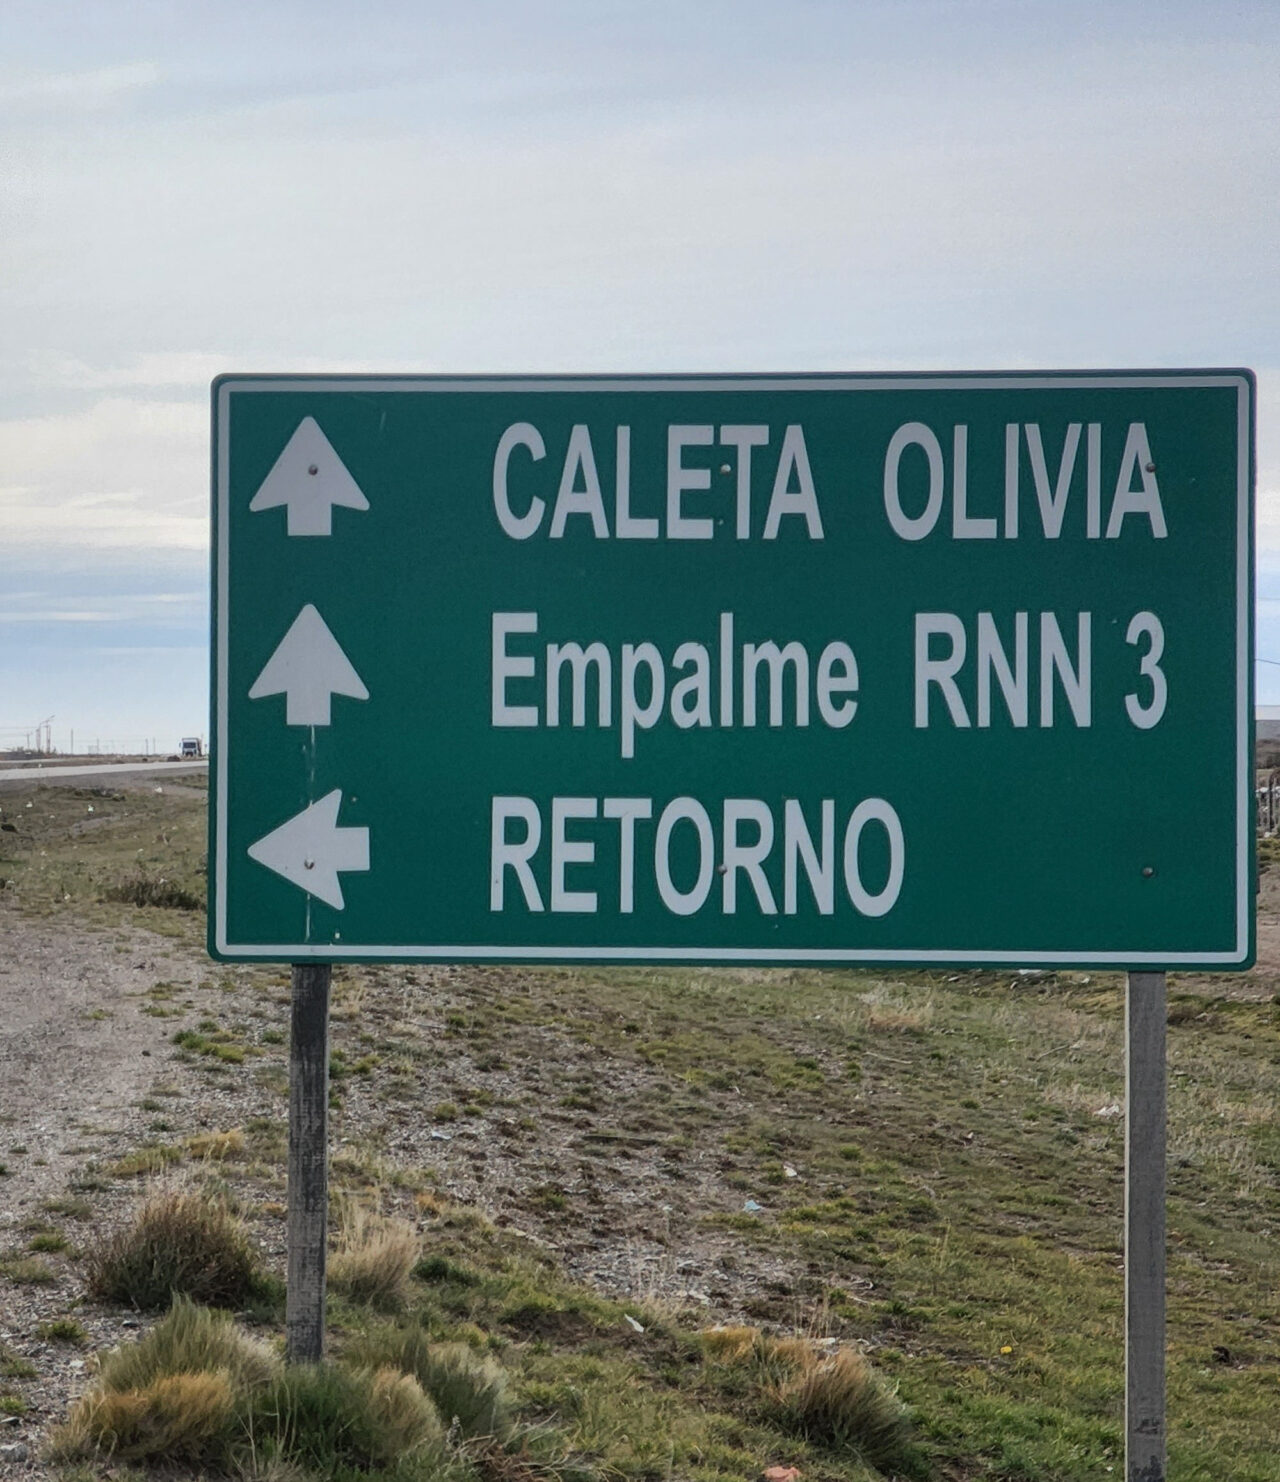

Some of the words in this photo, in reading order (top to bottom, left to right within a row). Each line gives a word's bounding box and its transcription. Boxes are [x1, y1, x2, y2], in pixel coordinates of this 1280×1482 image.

[494, 422, 825, 540] CALETA
[884, 422, 1169, 540] OLIVIA
[491, 612, 859, 759] Empalme
[914, 612, 1091, 728] RNN
[1124, 611, 1168, 729] 3
[490, 797, 905, 917] RETORNO
